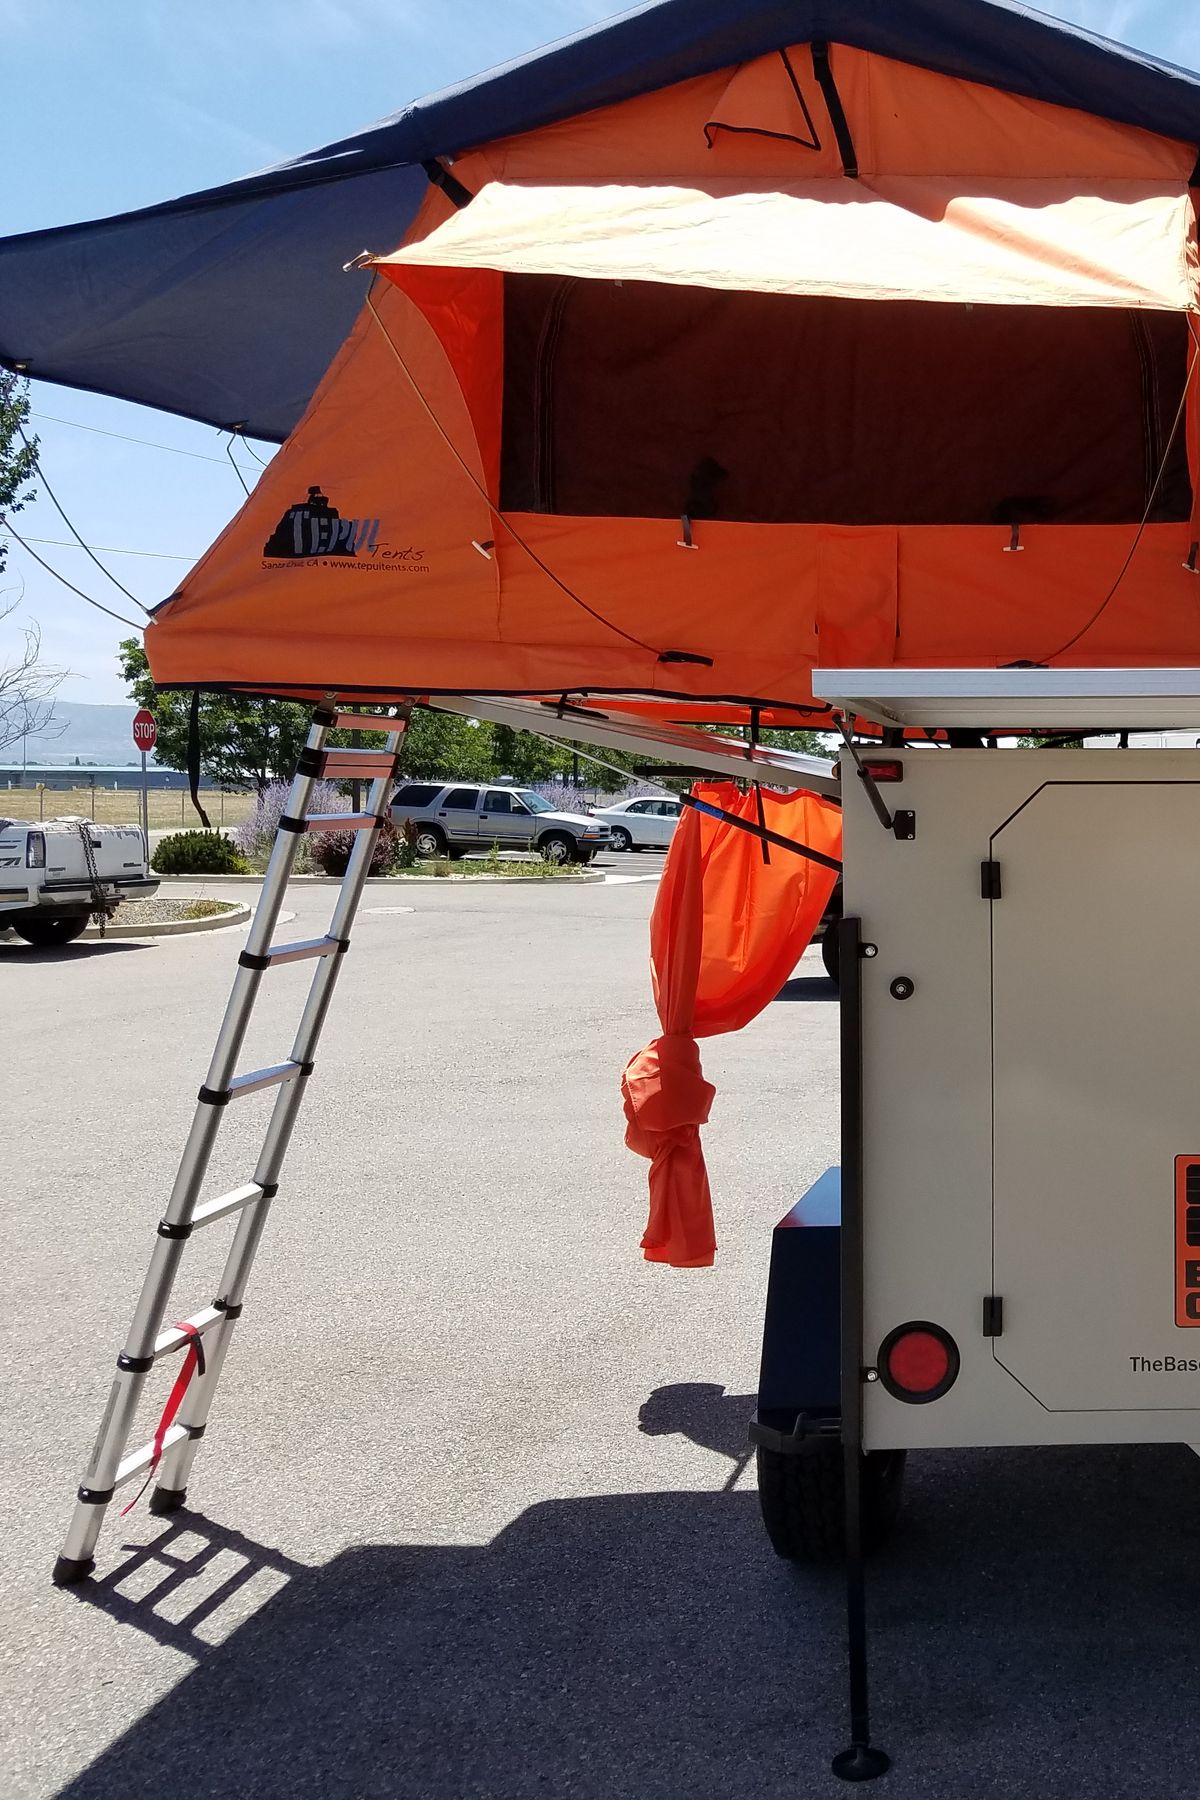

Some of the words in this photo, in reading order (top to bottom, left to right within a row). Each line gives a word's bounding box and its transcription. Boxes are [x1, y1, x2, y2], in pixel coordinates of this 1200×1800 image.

[369, 543, 425, 561] Tents
[330, 560, 430, 573] www.tepuitents.com
[134, 723, 155, 739] STOP
